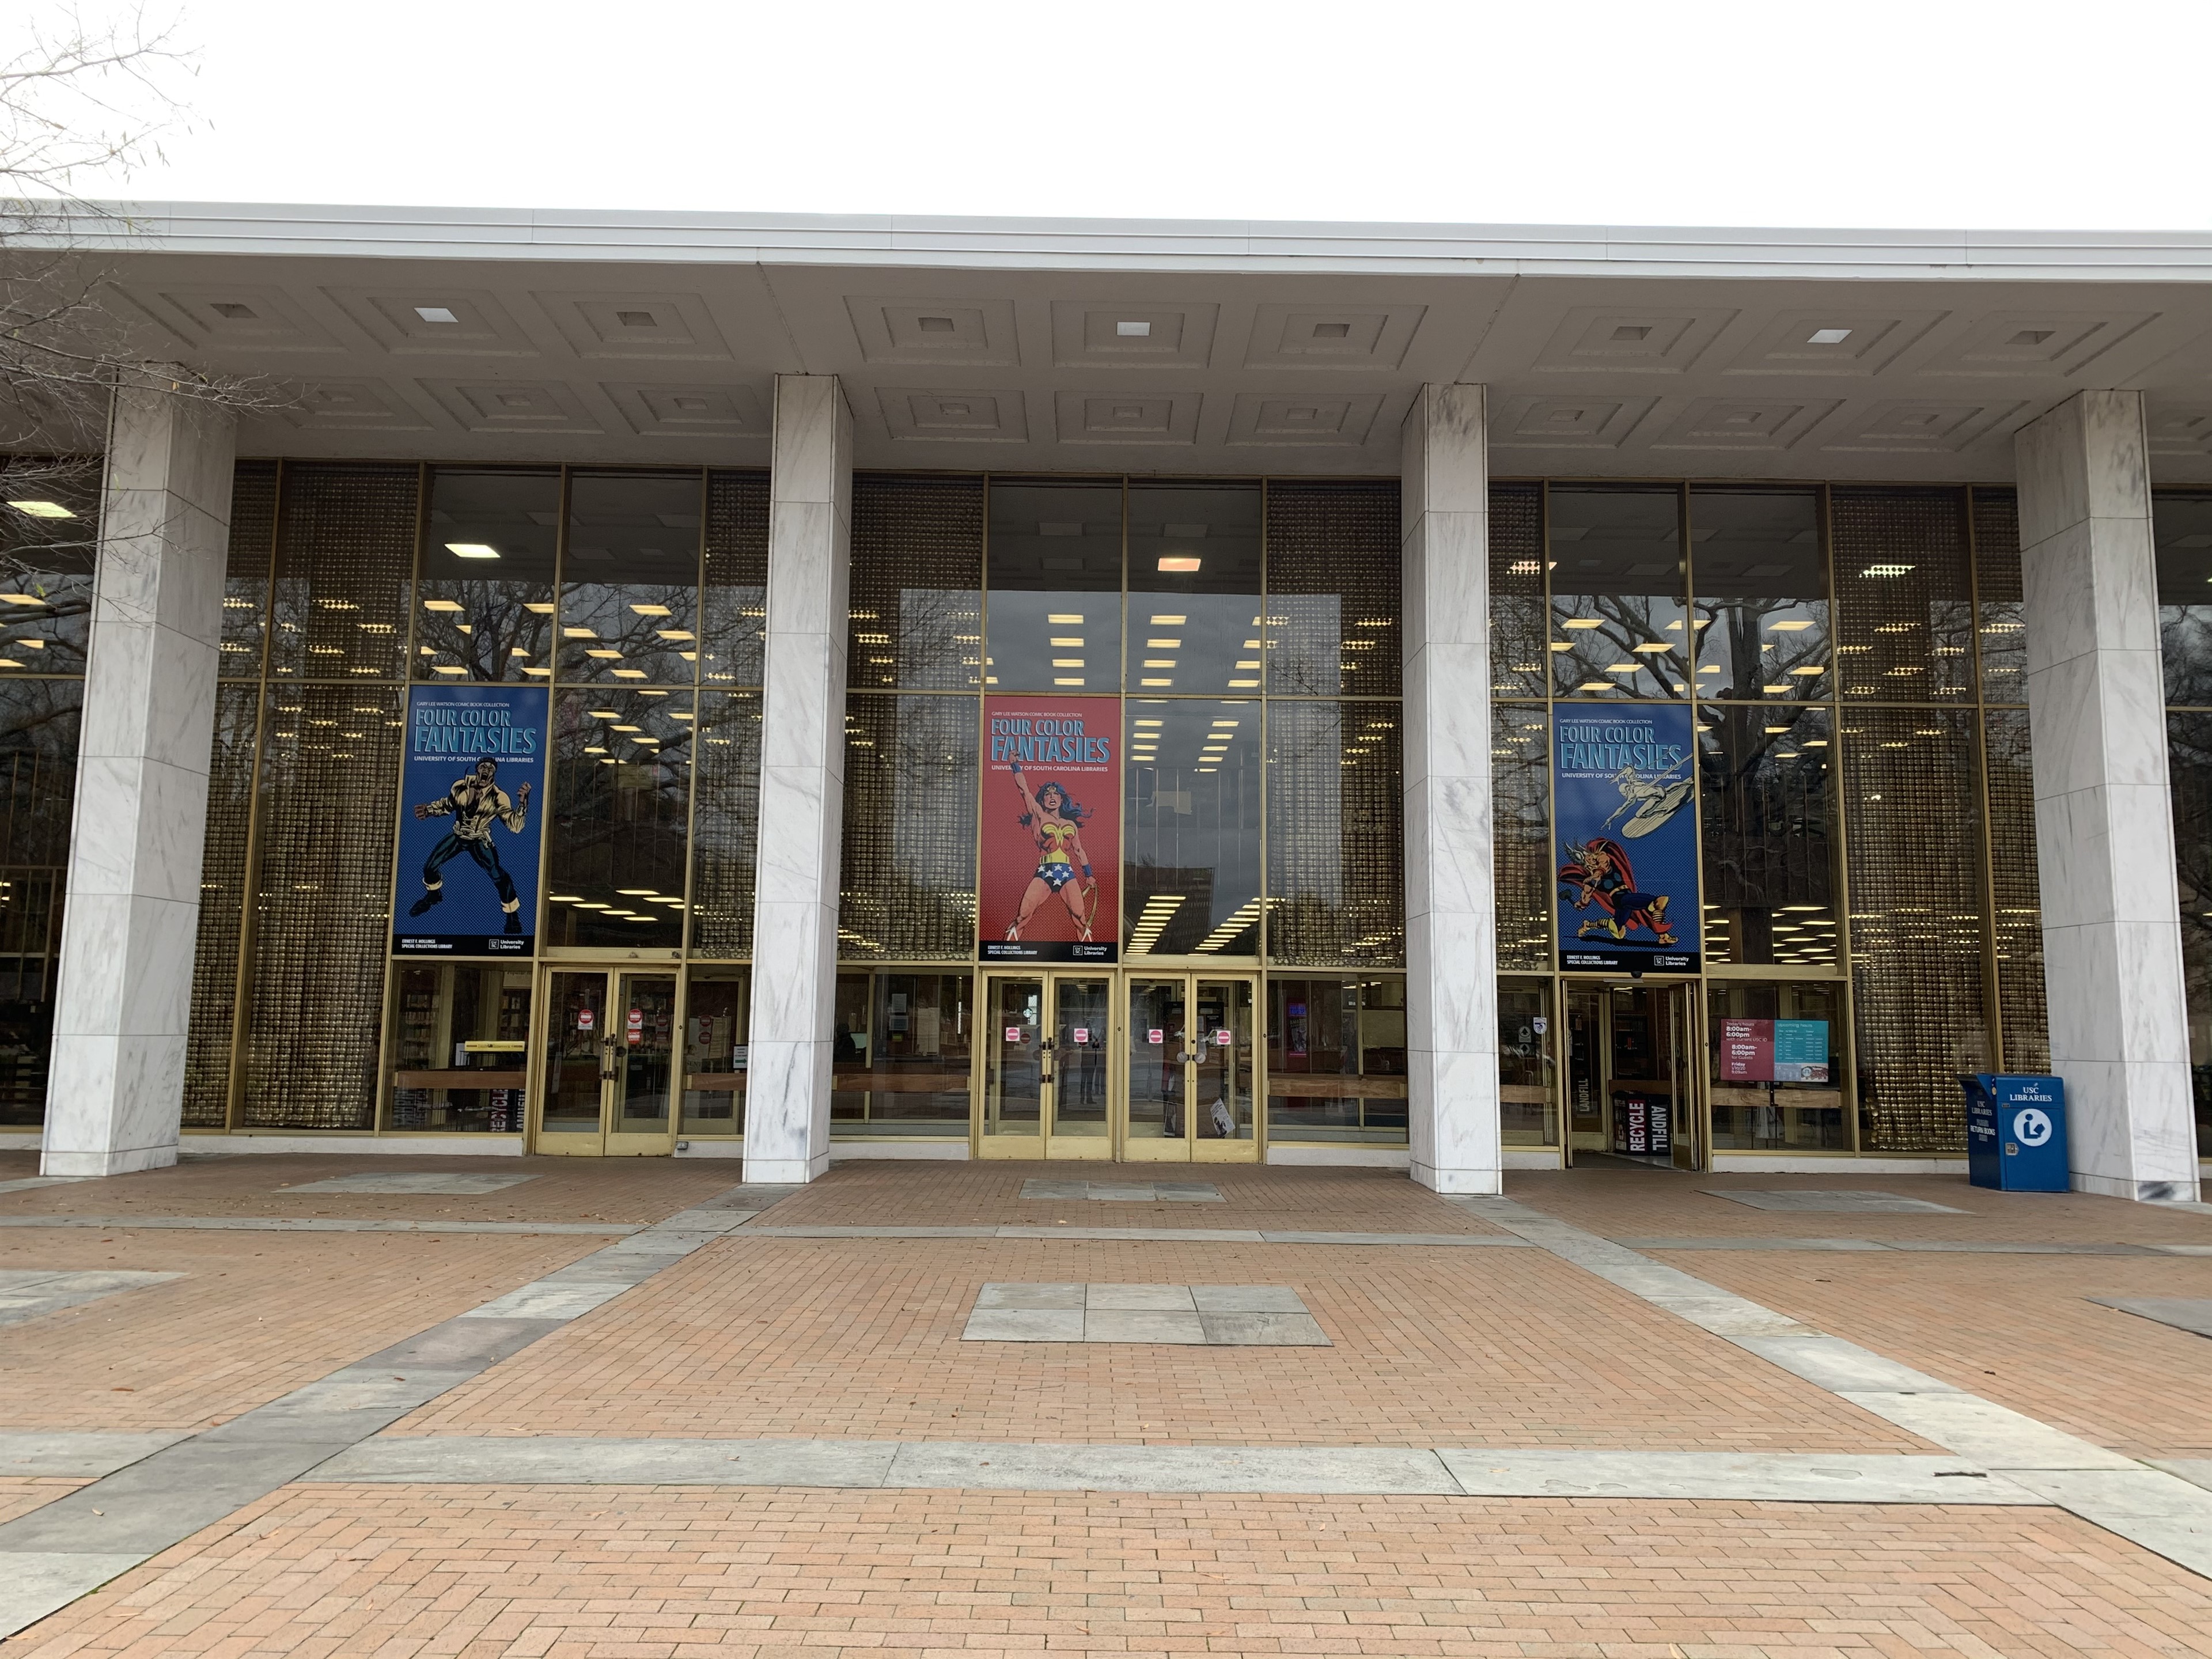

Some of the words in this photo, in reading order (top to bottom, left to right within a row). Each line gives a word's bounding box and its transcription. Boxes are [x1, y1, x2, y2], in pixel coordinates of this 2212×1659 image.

[416, 709, 457, 726] FOUR
[461, 710, 511, 726] COLOR
[991, 719, 1032, 735] FOUR
[1036, 719, 1084, 736] COLOR
[414, 726, 537, 753] FANTASIES
[1560, 726, 1601, 743] FOUR
[1605, 726, 1656, 743] COLOR
[991, 736, 1110, 763] FANTASIES
[1560, 743, 1682, 771] FANTASIES
[1578, 1078, 1590, 1112] LANDFILL
[1972, 1107, 1992, 1116] LIBRARIES
[1629, 1103, 1645, 1151] RECYCLE
[1651, 1105, 1668, 1151] ANDFILL
[1970, 1125, 1984, 1134] RETURN
[1984, 1127, 1995, 1135] BOOKS
